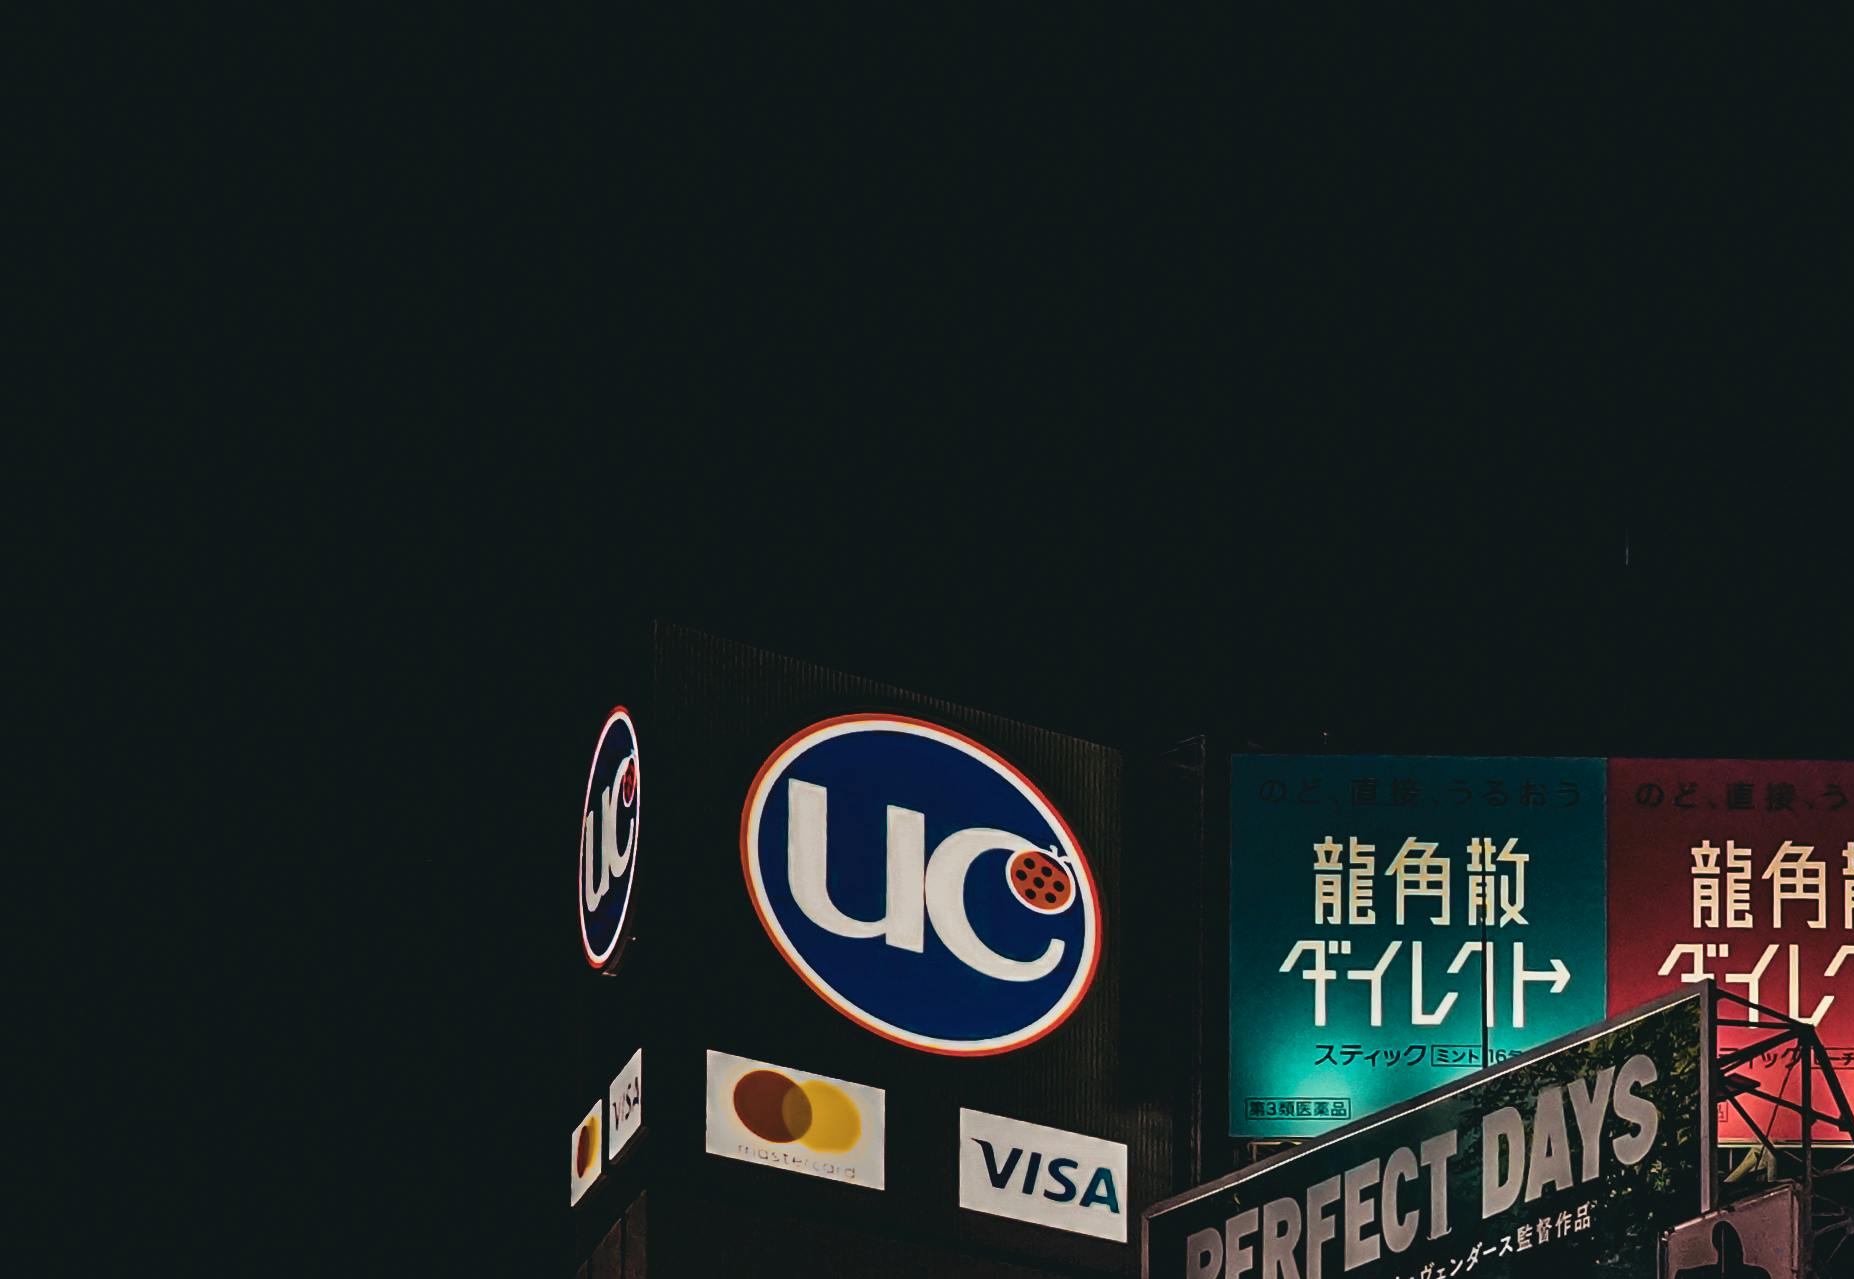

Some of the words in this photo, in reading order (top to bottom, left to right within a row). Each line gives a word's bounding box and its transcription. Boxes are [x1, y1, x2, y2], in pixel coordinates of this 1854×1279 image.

[787, 777, 1076, 983] UC
[1313, 835, 1530, 929] 龍角散
[1278, 939, 1572, 1029] ダイレクト
[1314, 1043, 1427, 1068] スティック
[970, 1136, 1121, 1214] VISA
[1480, 1053, 1661, 1221] DAYS
